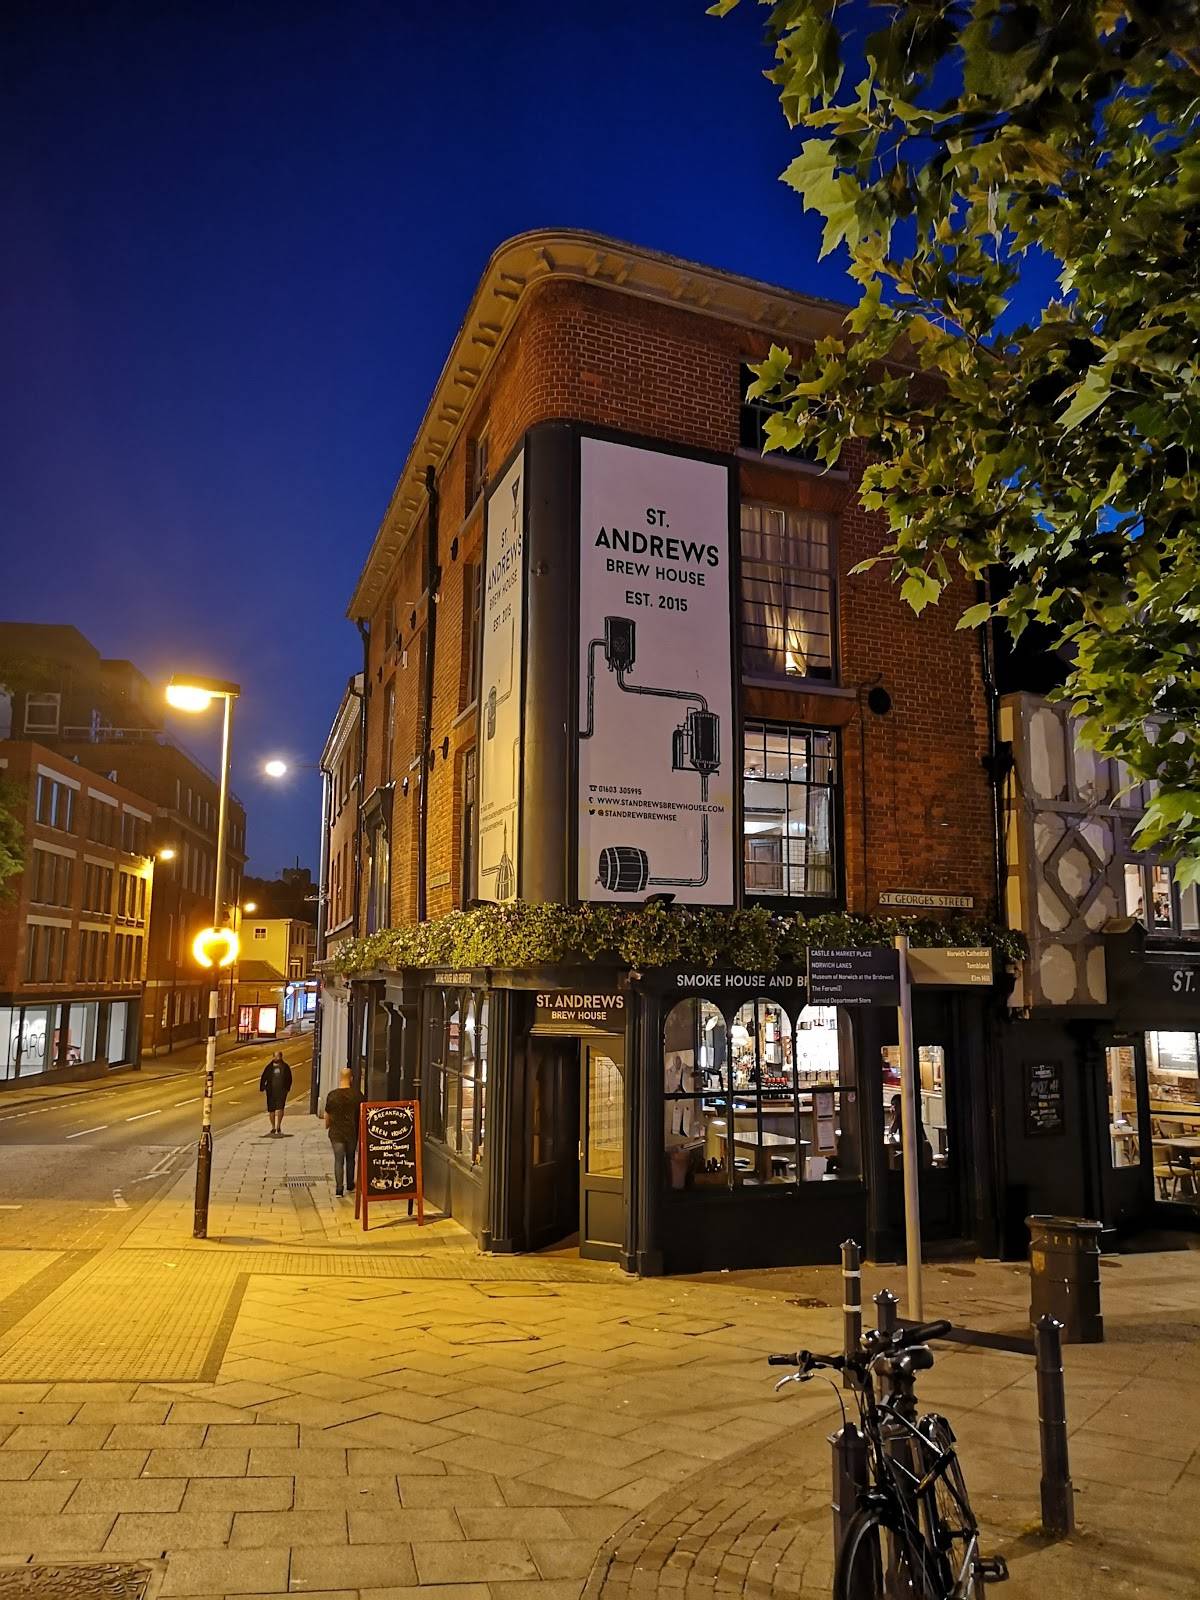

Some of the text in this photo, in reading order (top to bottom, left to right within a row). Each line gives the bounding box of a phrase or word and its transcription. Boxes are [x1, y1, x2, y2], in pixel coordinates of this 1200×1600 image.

[646, 508, 670, 528] ST.
[595, 526, 718, 567] ANDREWS
[488, 534, 522, 593] ANDREWS
[606, 558, 705, 586] BREW HOUSE
[626, 590, 688, 612] EST. 2015
[881, 893, 971, 907] ST GEORGES STREET
[677, 975, 721, 987] SMOKE
[725, 975, 765, 986] HOUSE
[769, 976, 793, 987] AND
[1172, 971, 1195, 992] ST.
[536, 994, 624, 1009] ST. ANDREWS
[552, 1011, 607, 1020] BREW HOUSE
[374, 1111, 406, 1121] BREAKFAST
[371, 1125, 408, 1136] BREW HOUSE
